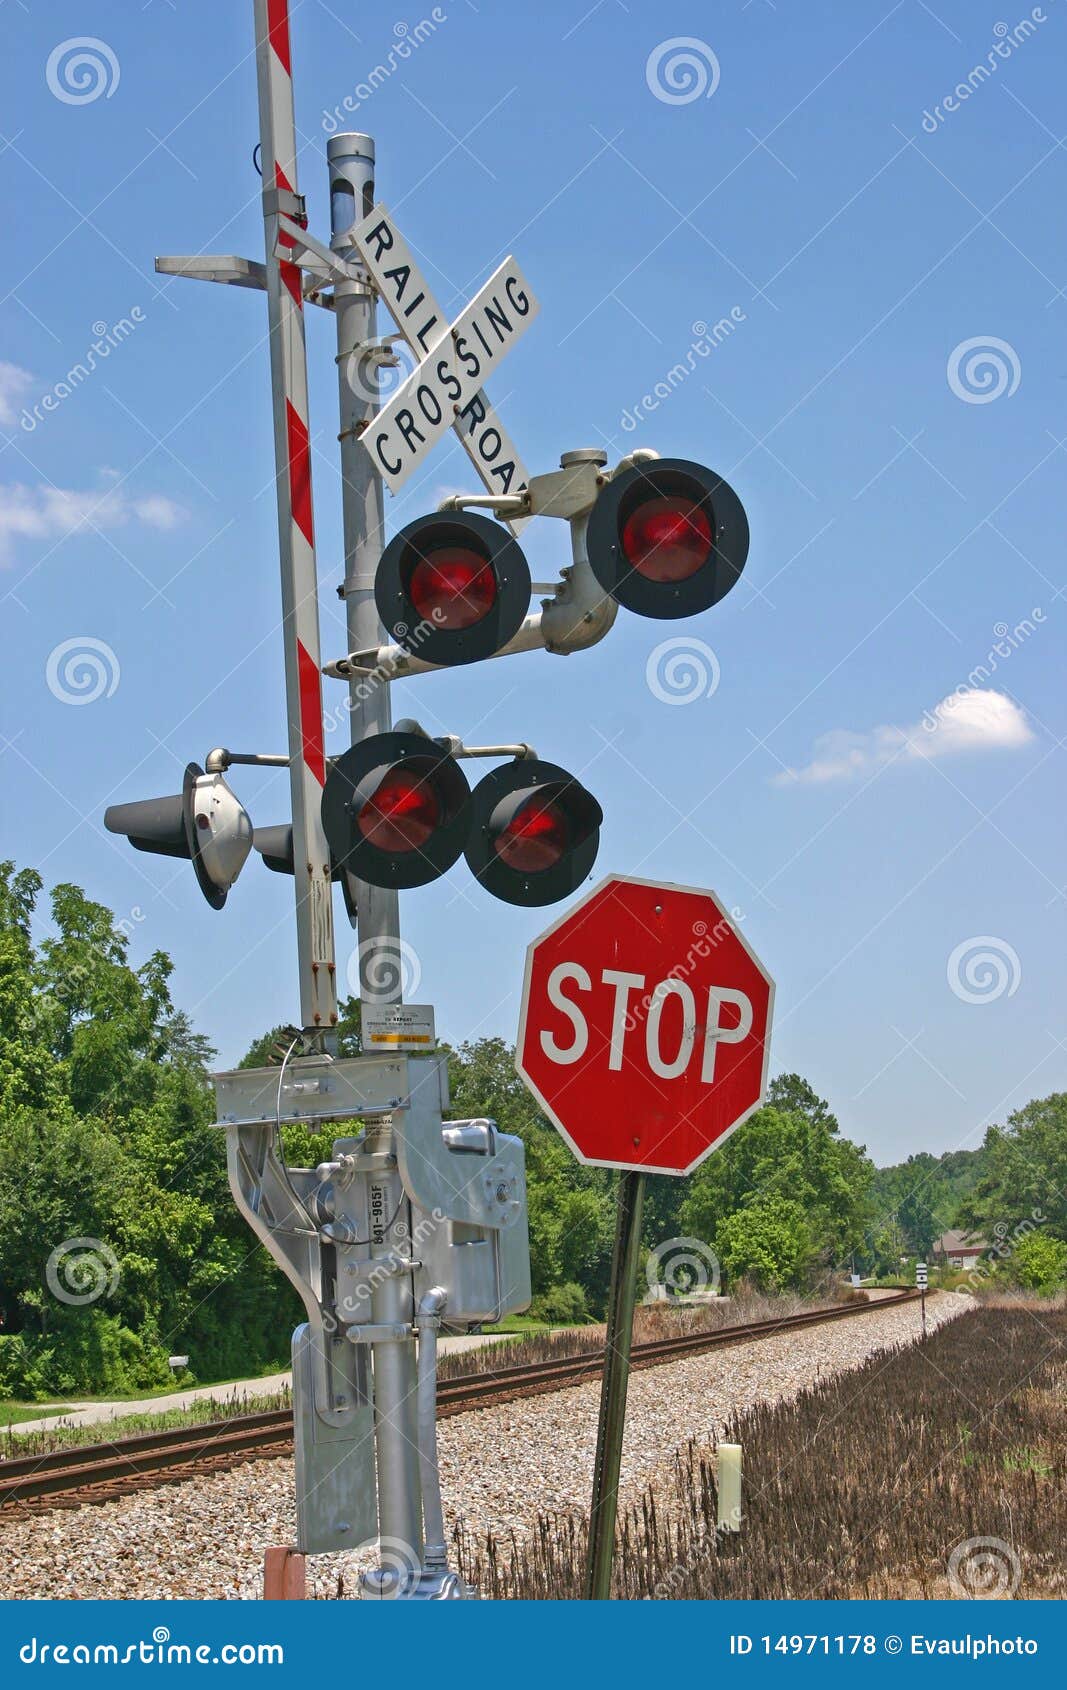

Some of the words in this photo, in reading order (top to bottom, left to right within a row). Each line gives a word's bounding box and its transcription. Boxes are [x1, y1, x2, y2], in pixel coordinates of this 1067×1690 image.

[365, 219, 437, 354] RAIL
[458, 394, 527, 495] ROA
[376, 277, 529, 476] CROSSING
[540, 962, 753, 1083] STOP
